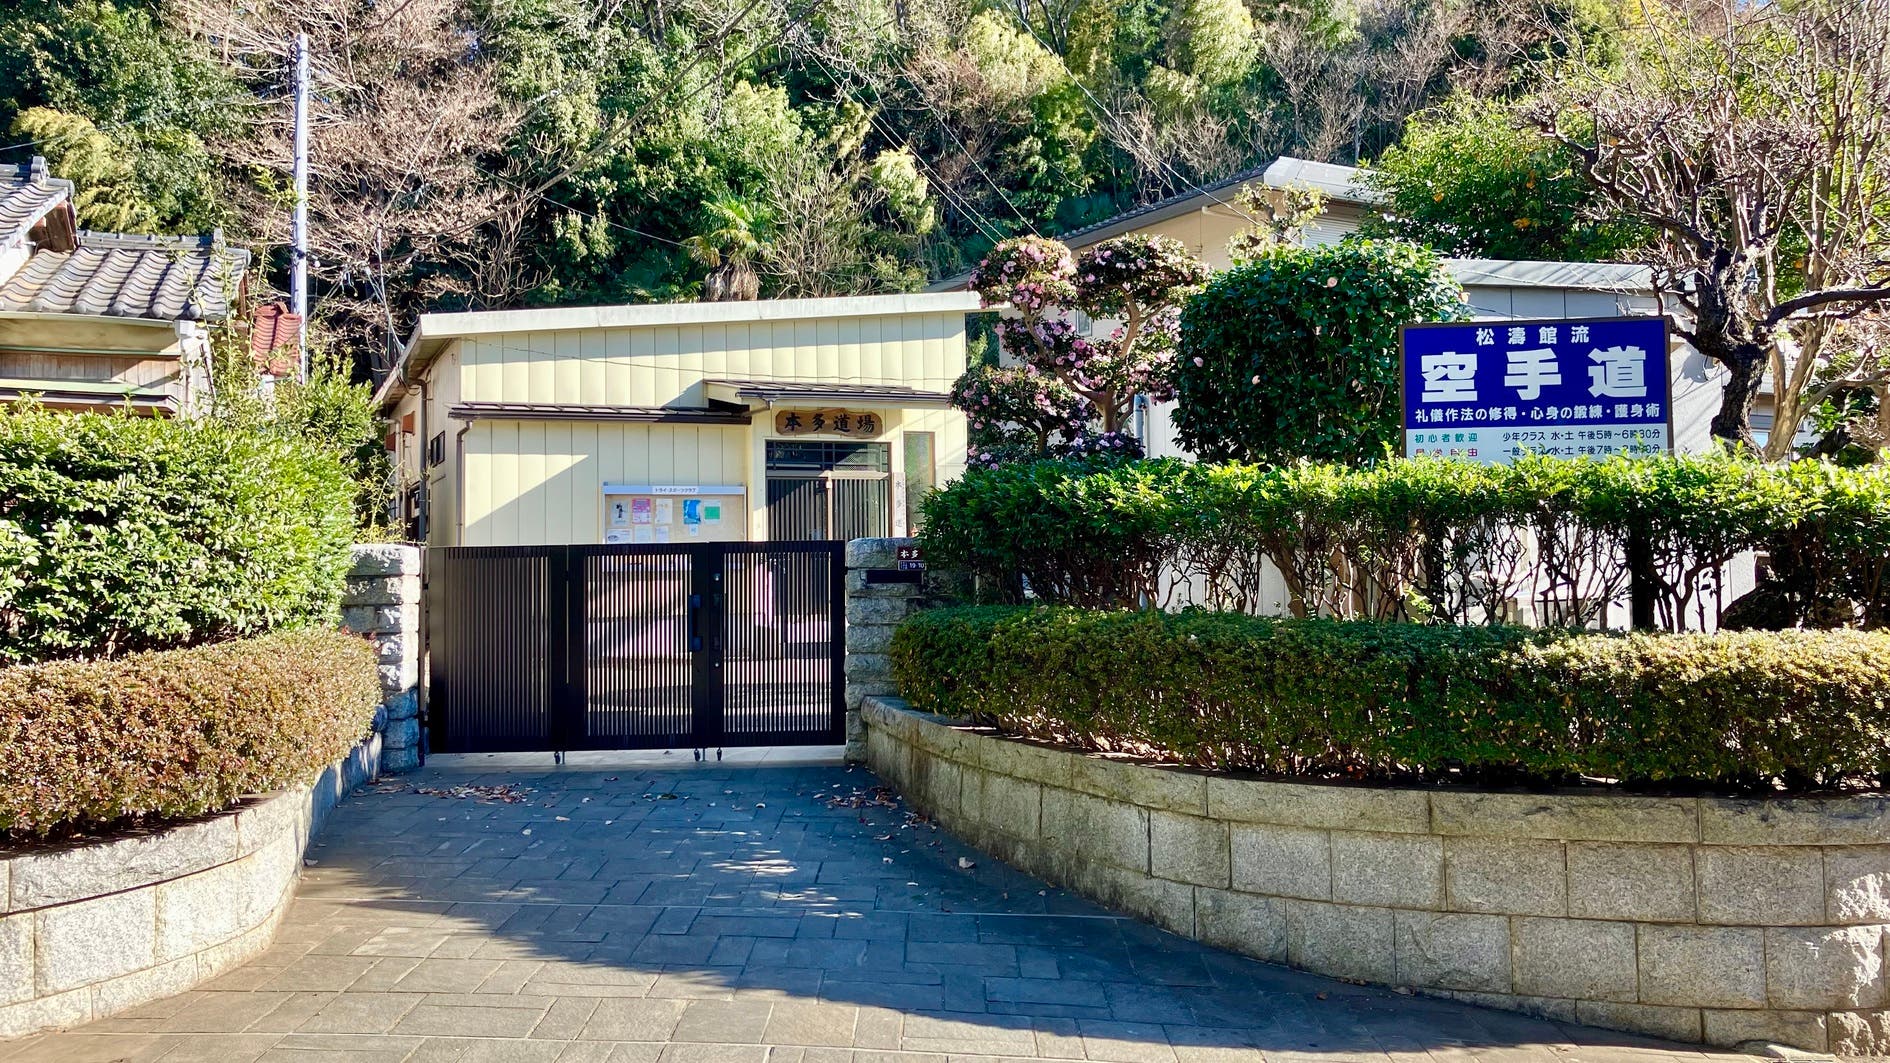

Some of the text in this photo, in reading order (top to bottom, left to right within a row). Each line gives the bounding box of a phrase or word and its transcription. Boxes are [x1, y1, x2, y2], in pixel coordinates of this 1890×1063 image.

[1476, 325, 1590, 346] 松濤館流
[1421, 345, 1647, 403] 空手道
[784, 412, 875, 433] 本多道場
[1502, 431, 1546, 442] 少年クラス
[900, 549, 919, 559] 本多
